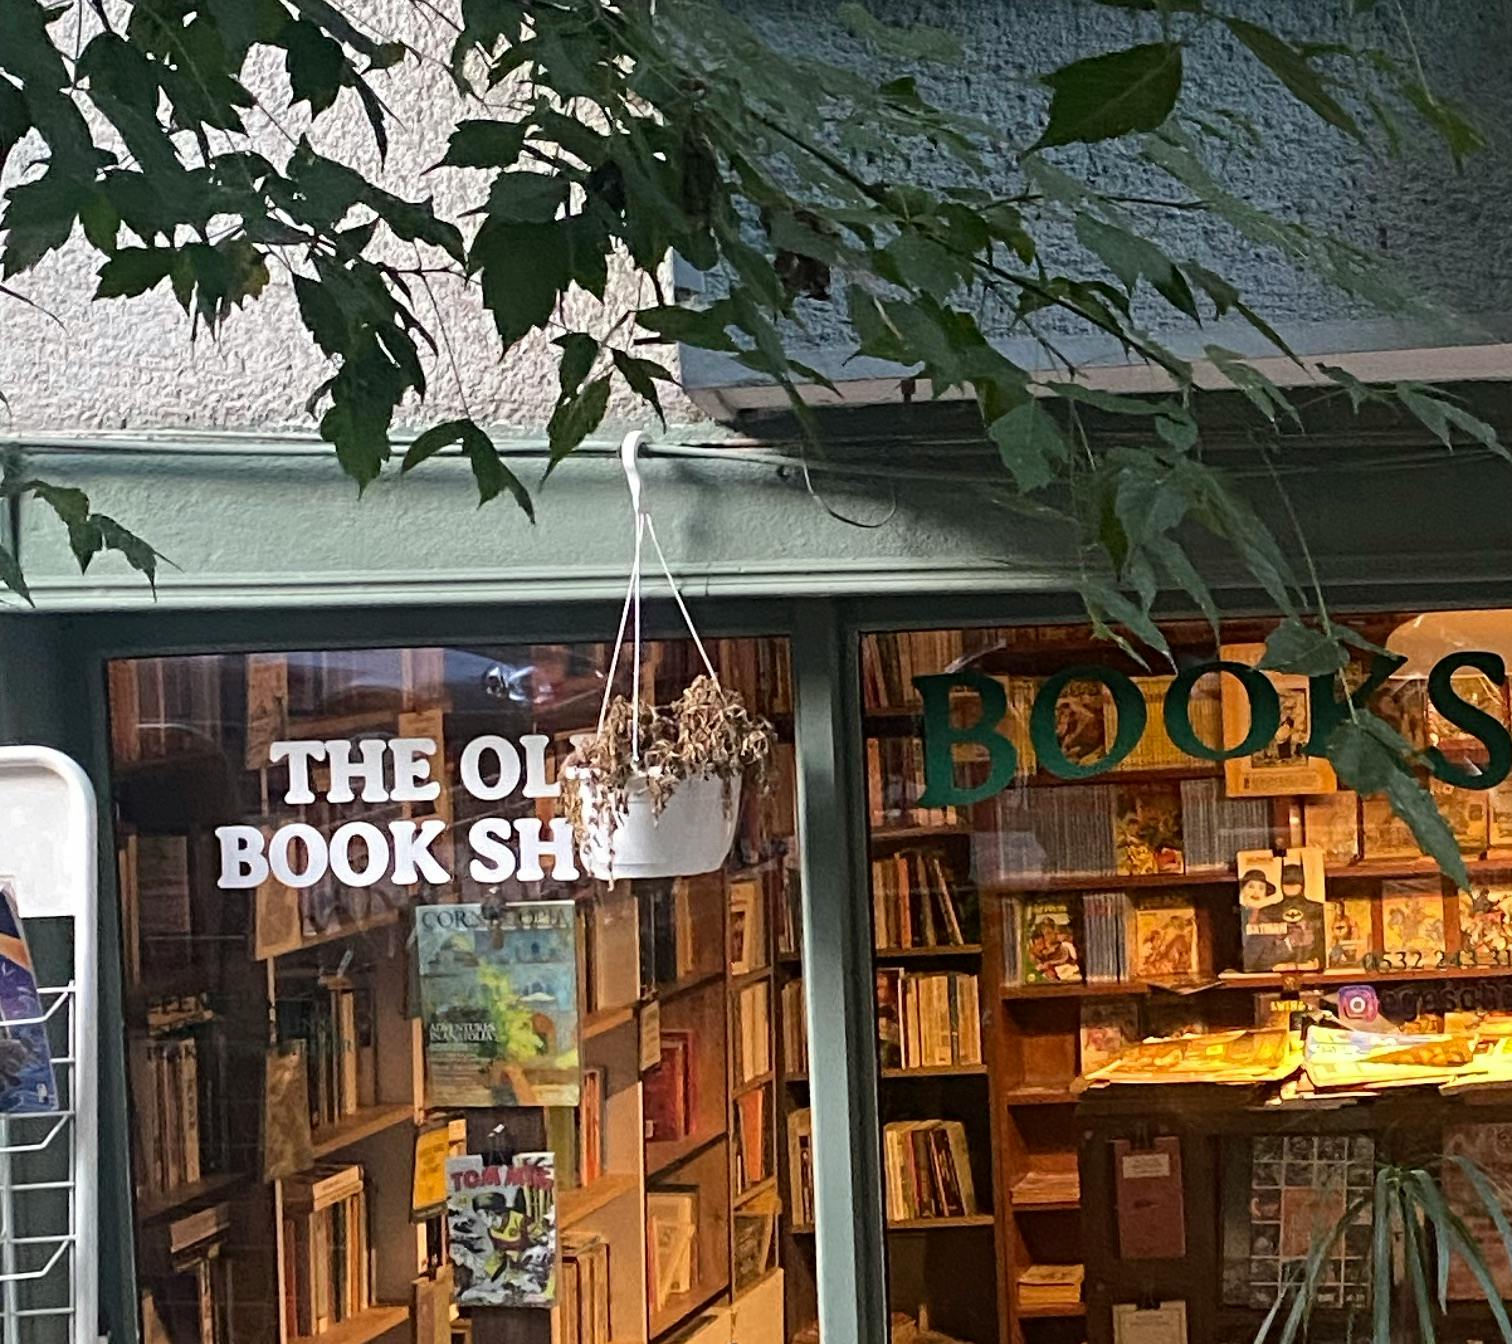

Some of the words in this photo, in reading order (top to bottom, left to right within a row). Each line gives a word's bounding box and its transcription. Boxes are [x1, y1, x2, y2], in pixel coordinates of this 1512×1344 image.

[270, 737, 441, 805] THE
[459, 734, 585, 800] OL
[215, 820, 451, 889] BOOK
[469, 817, 582, 883] SH
